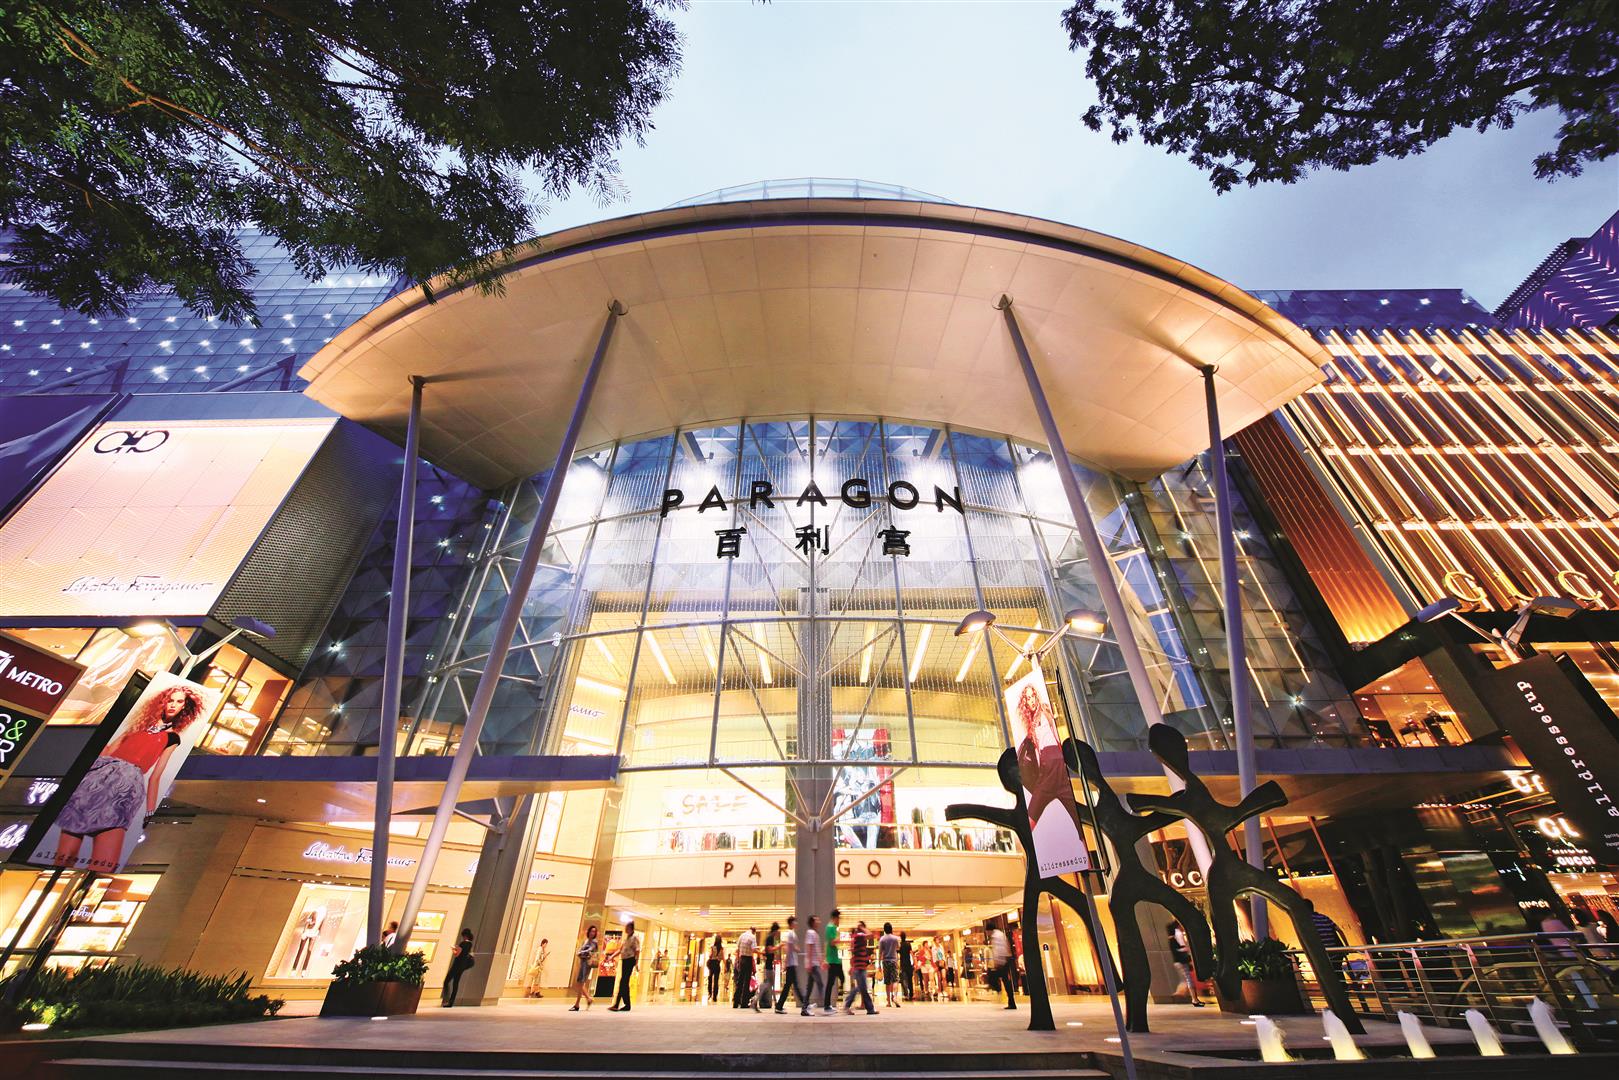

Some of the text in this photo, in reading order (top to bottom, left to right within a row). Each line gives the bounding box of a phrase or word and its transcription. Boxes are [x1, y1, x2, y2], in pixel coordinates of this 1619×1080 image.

[660, 479, 964, 518] PARAGON
[6, 666, 63, 695] METRO
[723, 859, 912, 878] PARGON
[1040, 856, 1088, 871] alldressedup
